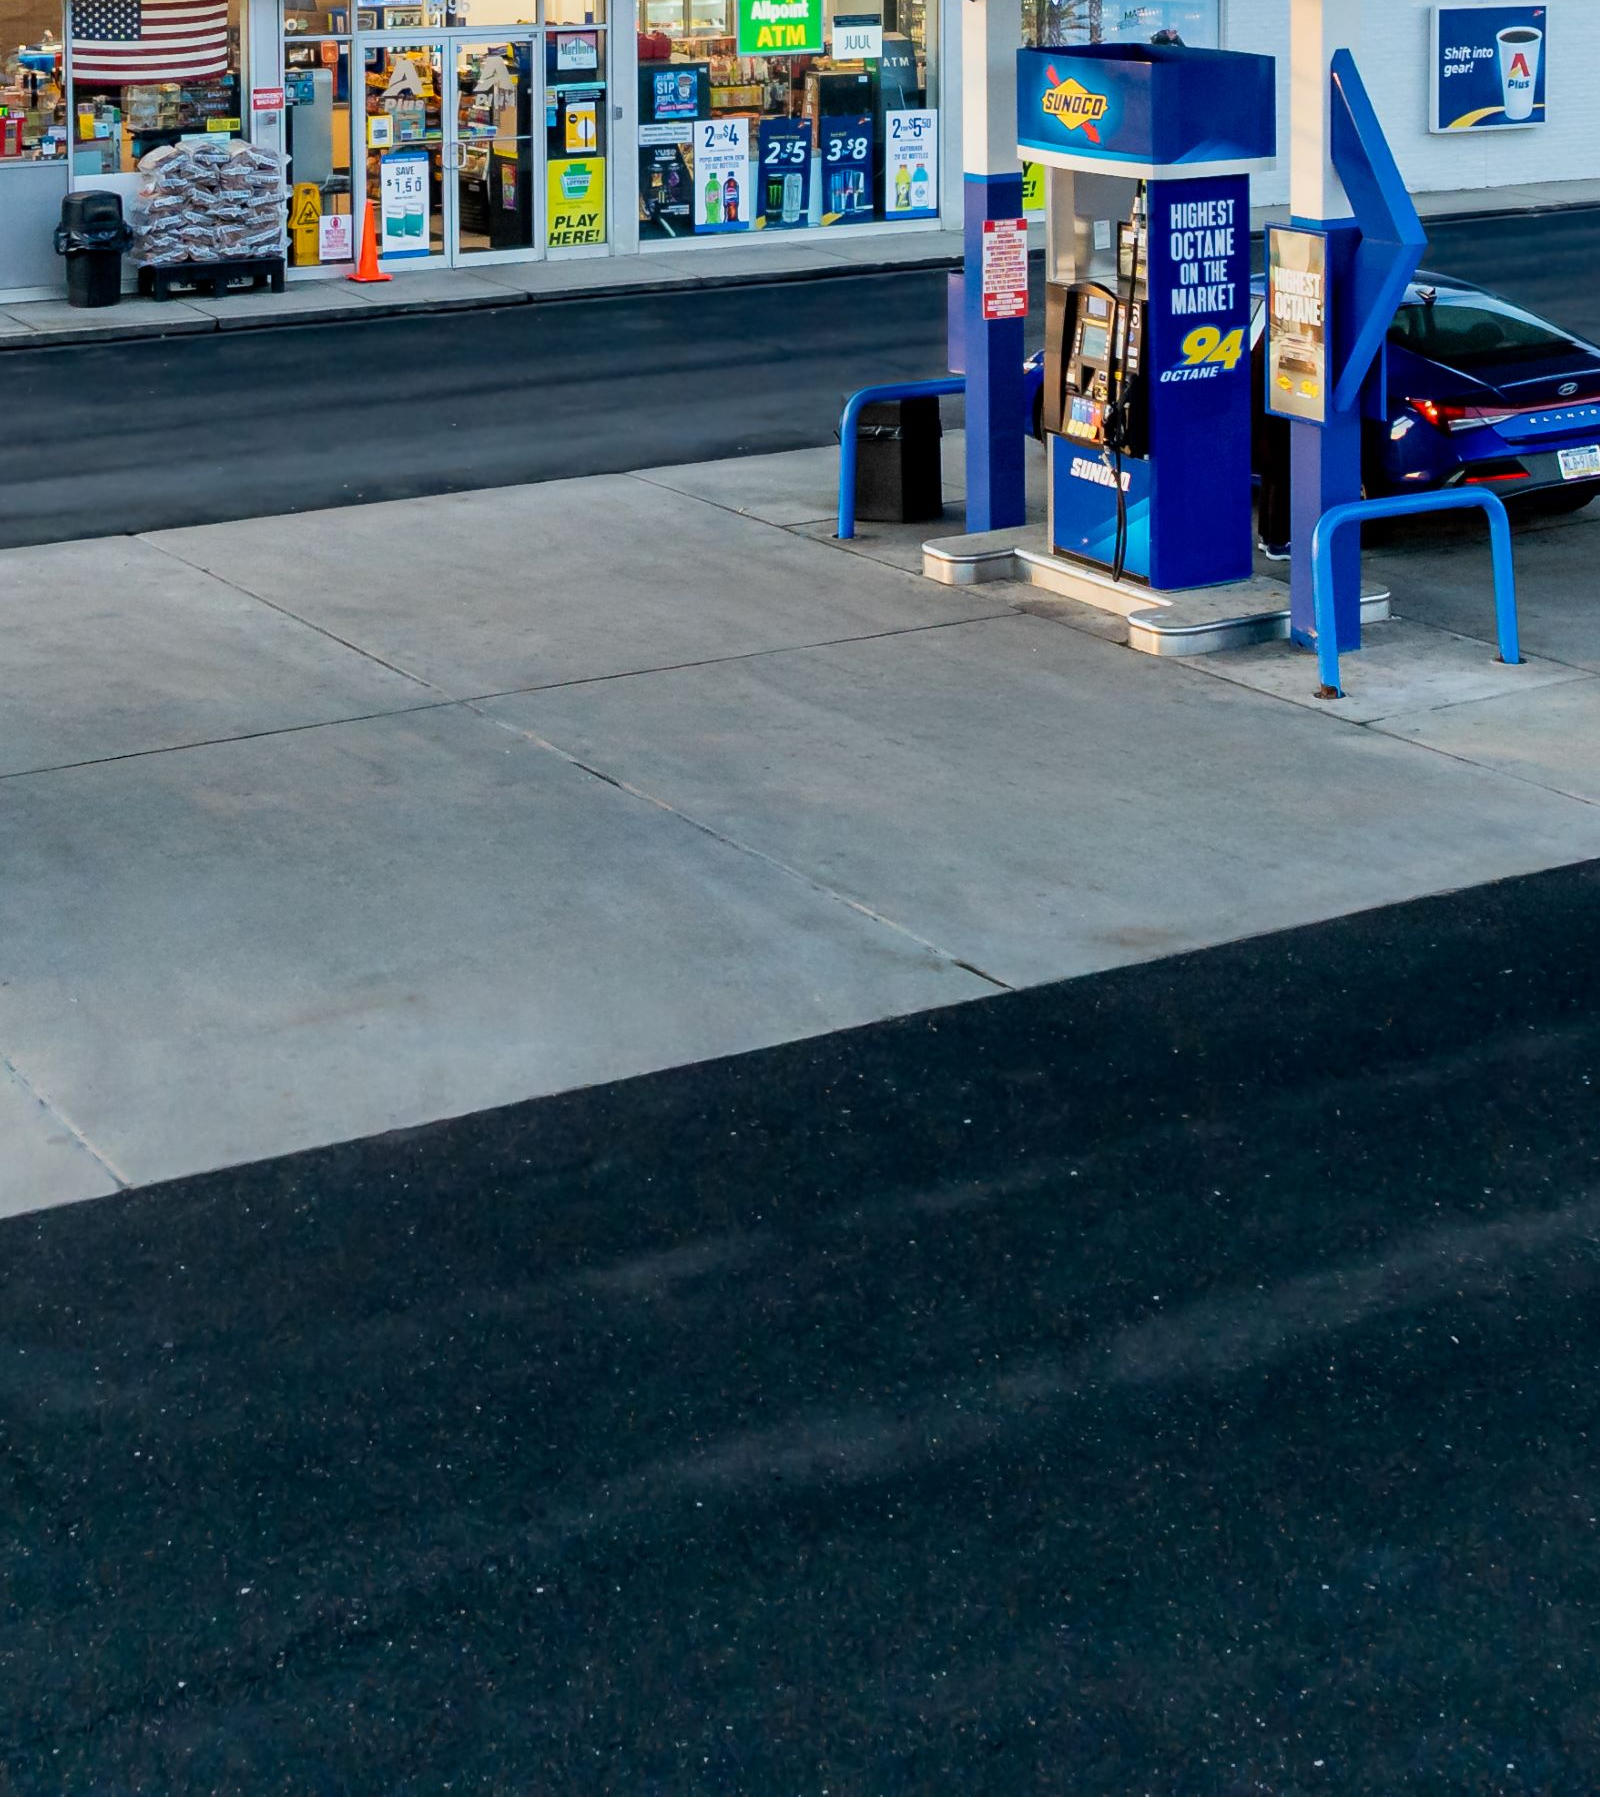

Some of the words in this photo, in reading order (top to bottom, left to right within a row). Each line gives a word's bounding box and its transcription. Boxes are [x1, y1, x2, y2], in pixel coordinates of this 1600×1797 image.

[757, 24, 807, 48] ATM
[844, 34, 872, 50] JUUL
[883, 56, 910, 68] ATM
[1444, 46, 1471, 62] Shift
[1472, 46, 1494, 58] into
[1444, 61, 1474, 78] gear!
[656, 82, 675, 94] SIP
[1507, 79, 1530, 89] Plus
[1046, 92, 1104, 116] SUNOCO
[705, 125, 715, 148] 2
[723, 123, 740, 146] $4
[893, 118, 901, 139] 2
[764, 142, 781, 164] 2
[786, 140, 807, 163] $5
[826, 139, 843, 162] 3
[847, 137, 868, 160] $8
[395, 166, 415, 176] SAVE
[554, 213, 599, 229] PLAY
[1170, 199, 1235, 230] HIGHEST
[549, 229, 600, 246] HERE!
[1170, 228, 1235, 262] OCTANE
[1180, 262, 1199, 285] ON
[1203, 259, 1228, 284] THE
[1274, 265, 1322, 299] HIGHEST
[1171, 283, 1236, 316] MARKET
[1274, 291, 1322, 327] OCTANE
[1181, 326, 1245, 370] 94
[1160, 365, 1219, 383] OCTANE
